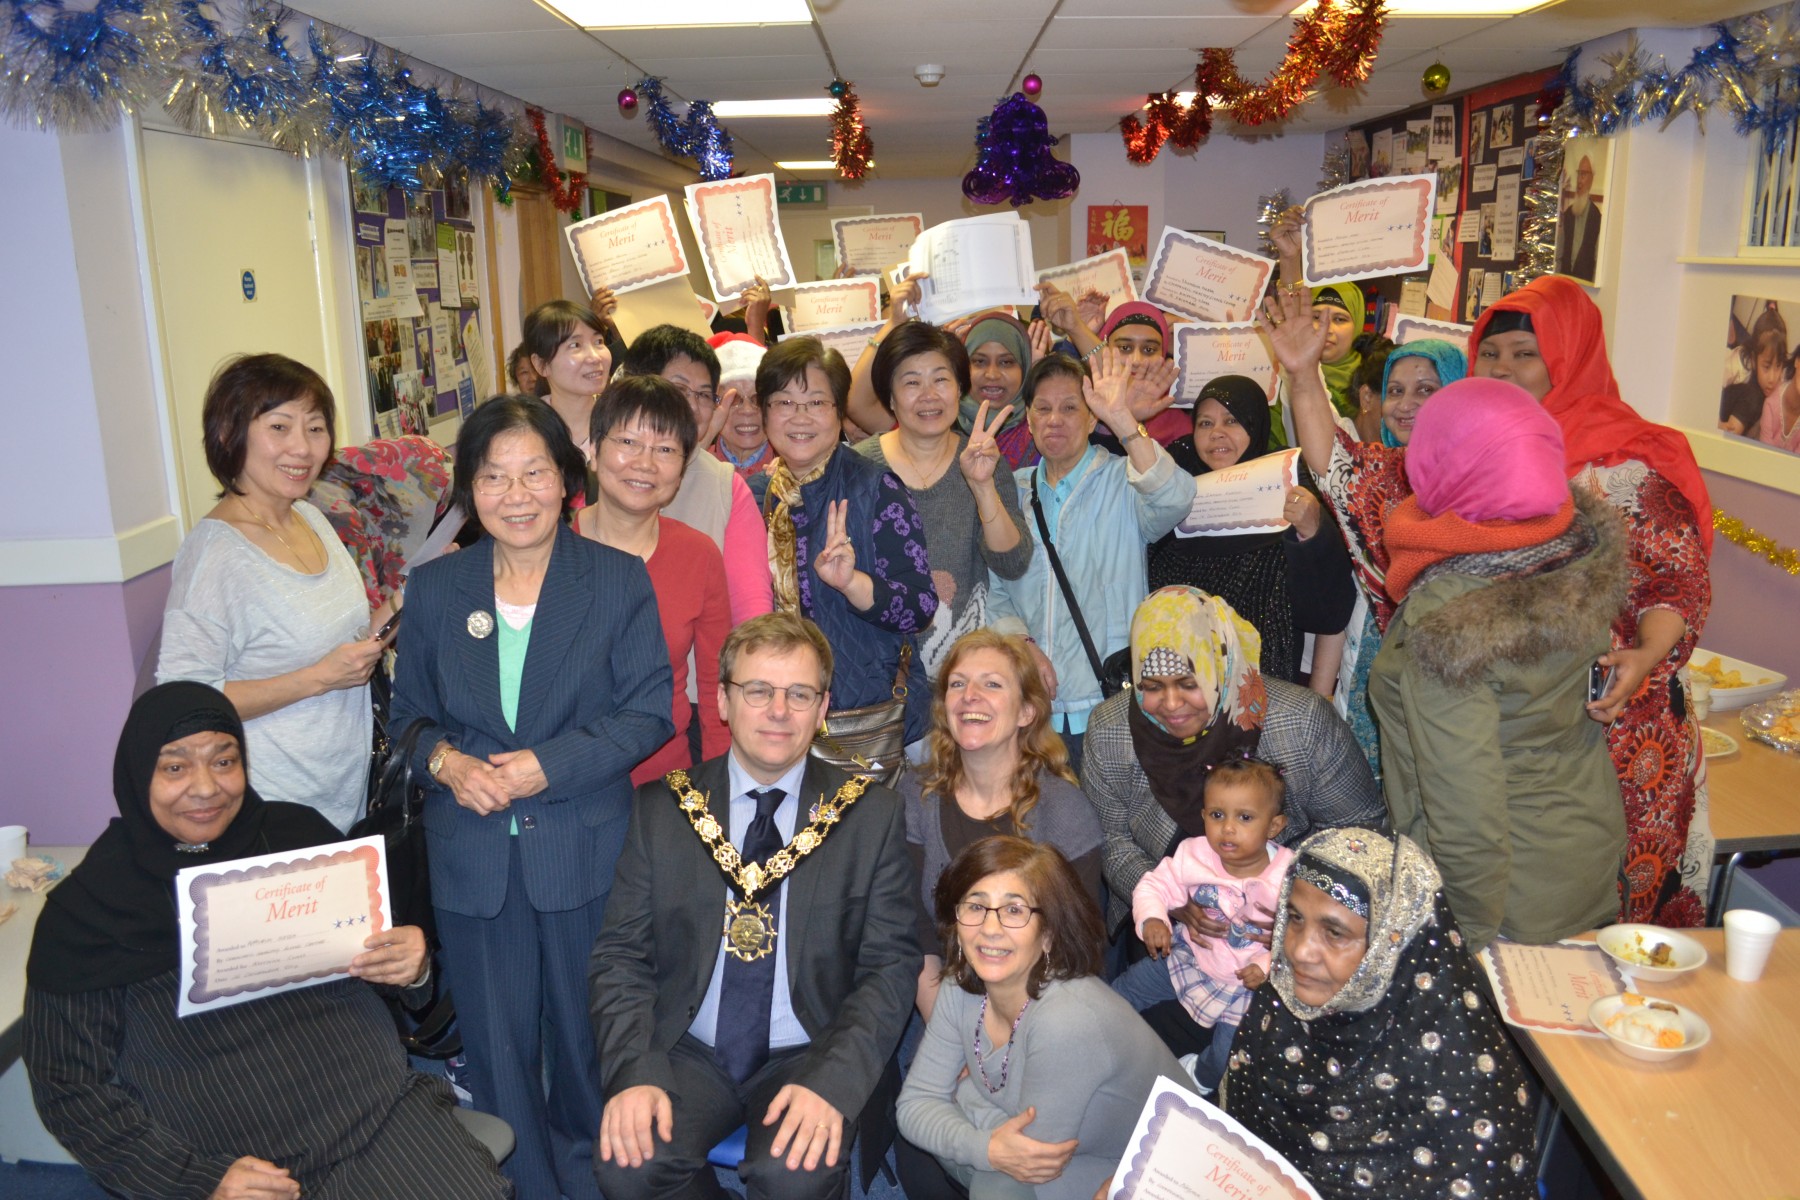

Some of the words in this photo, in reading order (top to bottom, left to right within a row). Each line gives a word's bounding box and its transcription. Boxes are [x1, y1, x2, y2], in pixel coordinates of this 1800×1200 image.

[1340, 198, 1378, 210] Certificate
[1380, 196, 1391, 207] of
[1101, 208, 1134, 241] 福
[1345, 208, 1380, 224] Merit
[608, 232, 636, 249] Merit
[869, 231, 892, 241] Merit
[1195, 255, 1229, 270] Certificate
[1228, 266, 1237, 274] of
[1195, 266, 1228, 284] Merit
[816, 304, 843, 315] Merit
[1212, 341, 1242, 349] Certificate
[1243, 339, 1251, 349] of
[1217, 349, 1246, 361] Merit
[1216, 469, 1249, 483] Merit
[255, 880, 312, 901] Certificate
[315, 875, 328, 893] of
[265, 896, 320, 923] Merit
[1568, 972, 1592, 999] Merit
[1206, 1143, 1256, 1184] Certificate
[1257, 1184, 1272, 1197] of
[1205, 1165, 1253, 1200] Meri
